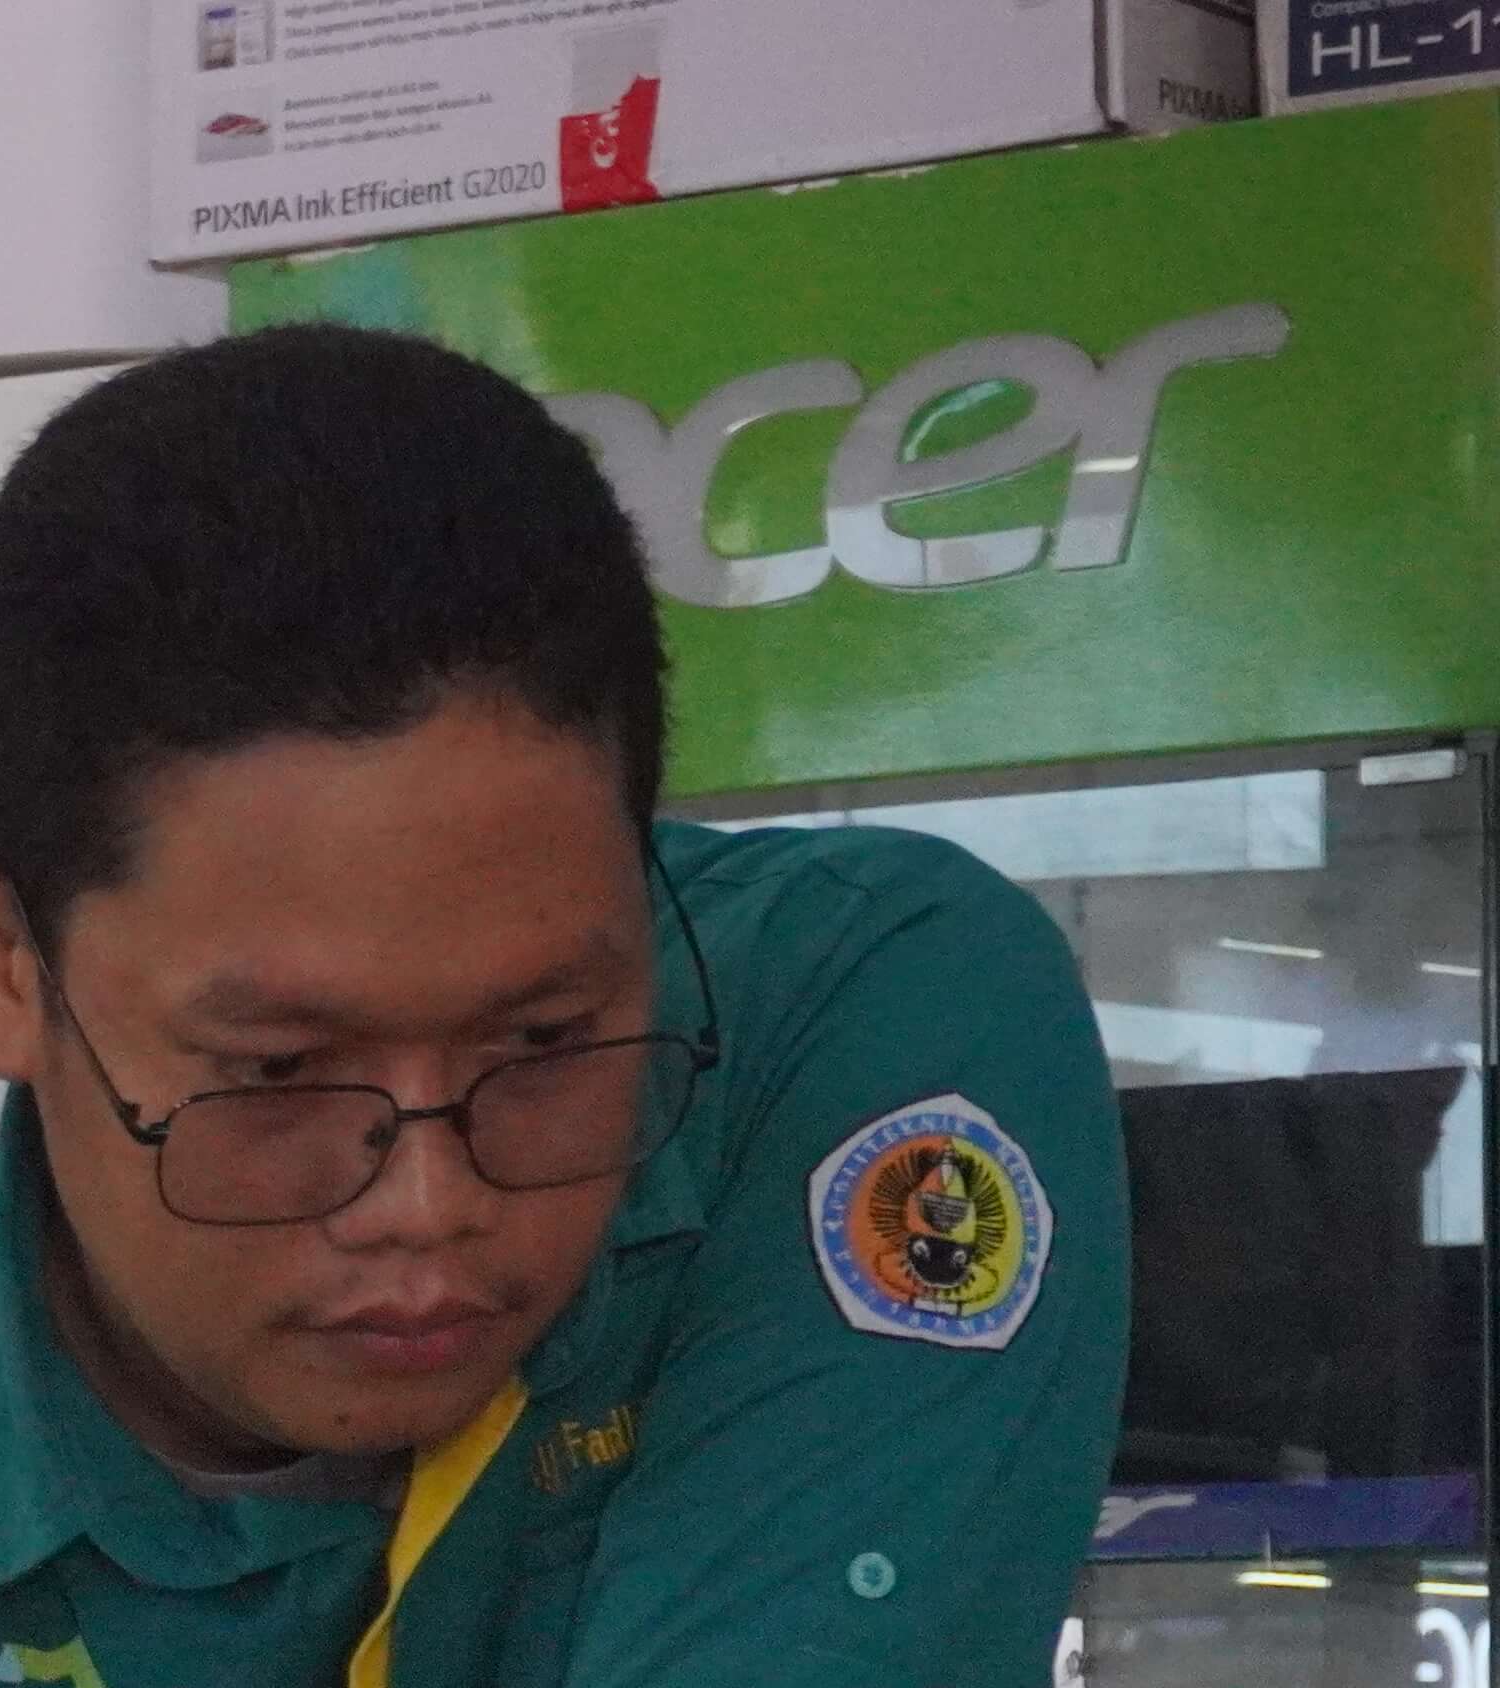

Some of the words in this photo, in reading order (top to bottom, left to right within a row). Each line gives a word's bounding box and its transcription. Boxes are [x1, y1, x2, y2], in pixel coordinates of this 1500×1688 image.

[1311, 8, 1500, 76] HL-1
[193, 196, 292, 236] PIXMA
[299, 189, 335, 222] Ink
[341, 175, 455, 217] Efficient
[463, 160, 547, 200] G2020
